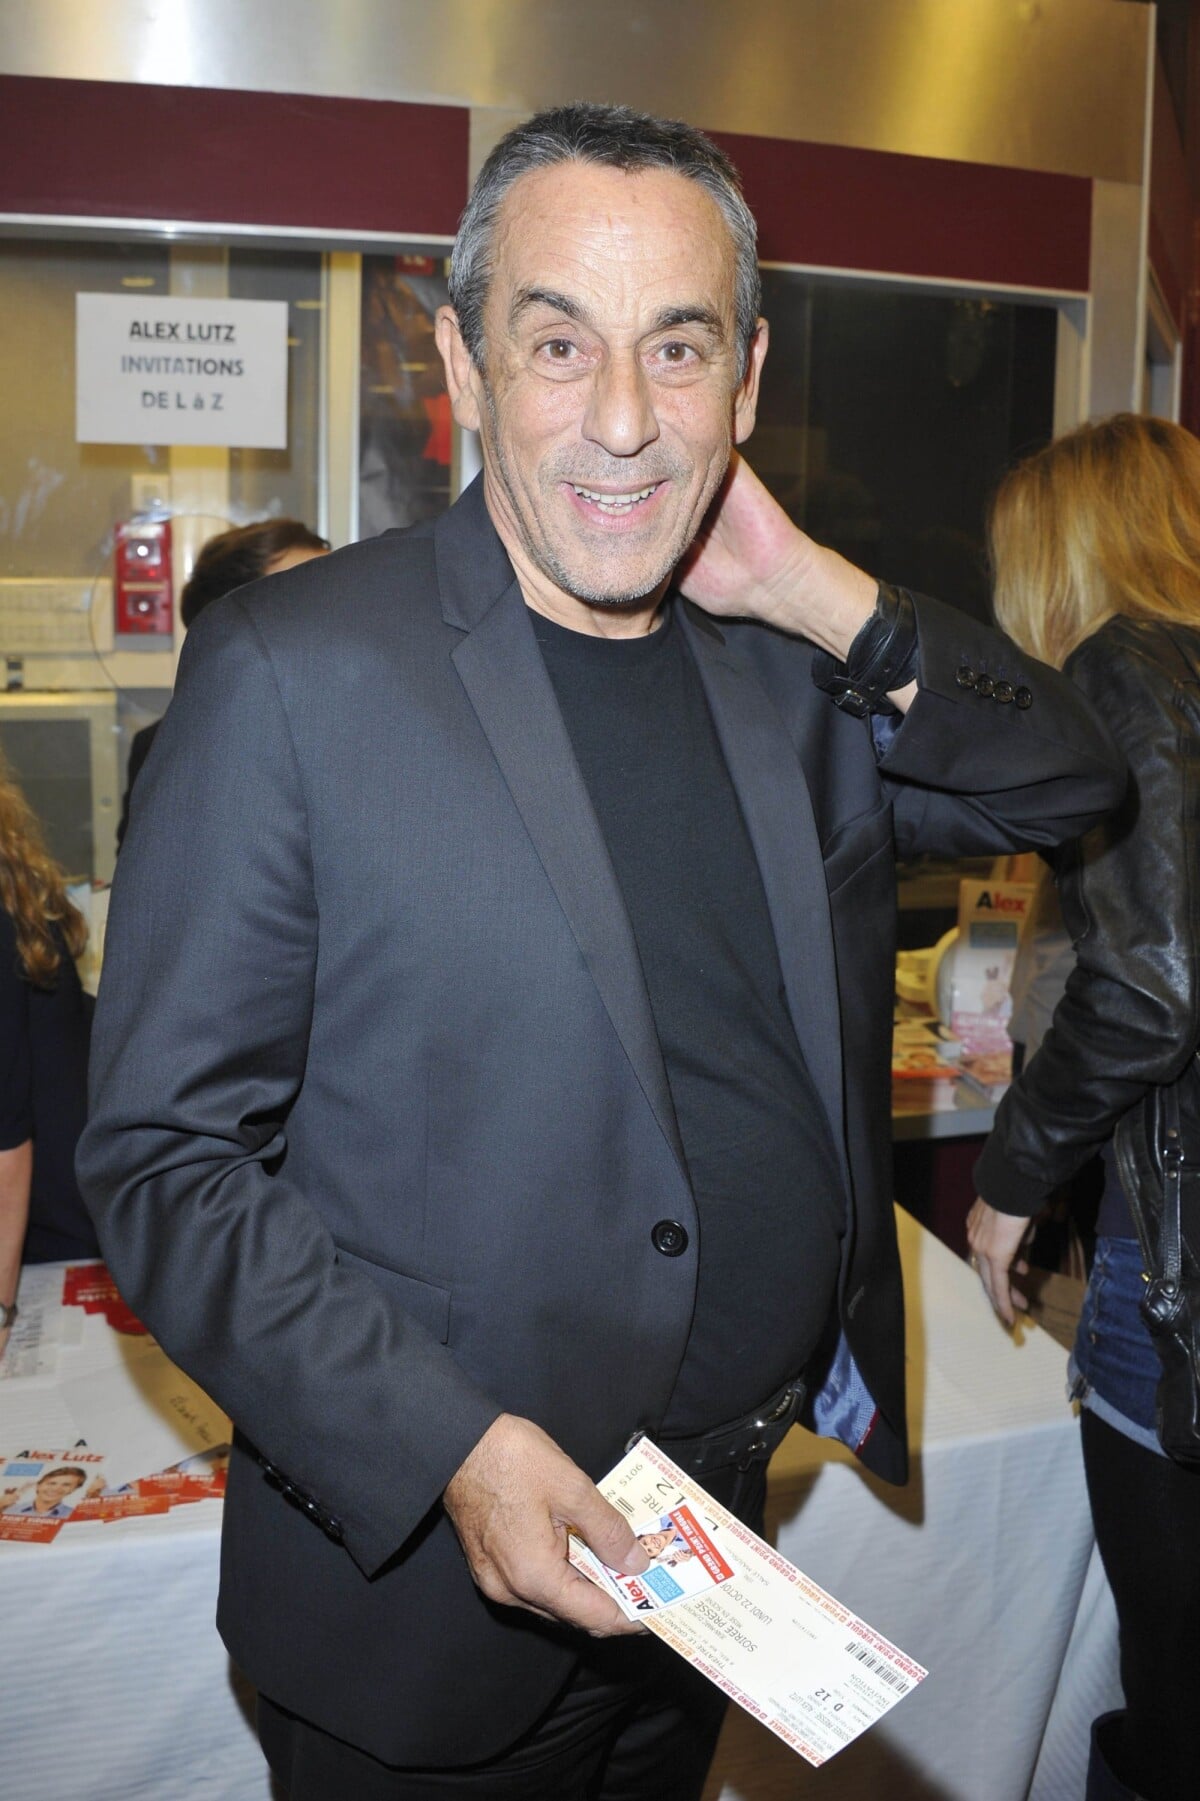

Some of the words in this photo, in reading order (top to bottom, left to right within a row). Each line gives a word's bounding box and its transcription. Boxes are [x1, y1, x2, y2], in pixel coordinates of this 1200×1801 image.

[130, 321, 180, 339] ALEX
[187, 324, 236, 342] LUTZ
[121, 355, 245, 376] INVITATIONS
[141, 390, 169, 409] DE
[176, 392, 187, 409] L
[211, 393, 225, 411] Z
[976, 890, 1026, 913] Alex
[16, 1449, 55, 1461] Alex
[61, 1451, 105, 1463] Lutz
[725, 1522, 752, 1545] VIRGULE
[620, 1579, 654, 1614] Alex
[739, 1597, 753, 1609] 22
[693, 1599, 727, 1629] PRESSE
[748, 1604, 773, 1626] LUNDI
[662, 1615, 689, 1638] GRAND
[845, 1619, 875, 1644] VIRGULE
[686, 1635, 697, 1645] LE
[723, 1623, 758, 1653] SOIREE
[694, 1642, 725, 1669] THEATRE
[813, 1686, 832, 1702] 12
[831, 1700, 845, 1712] D
